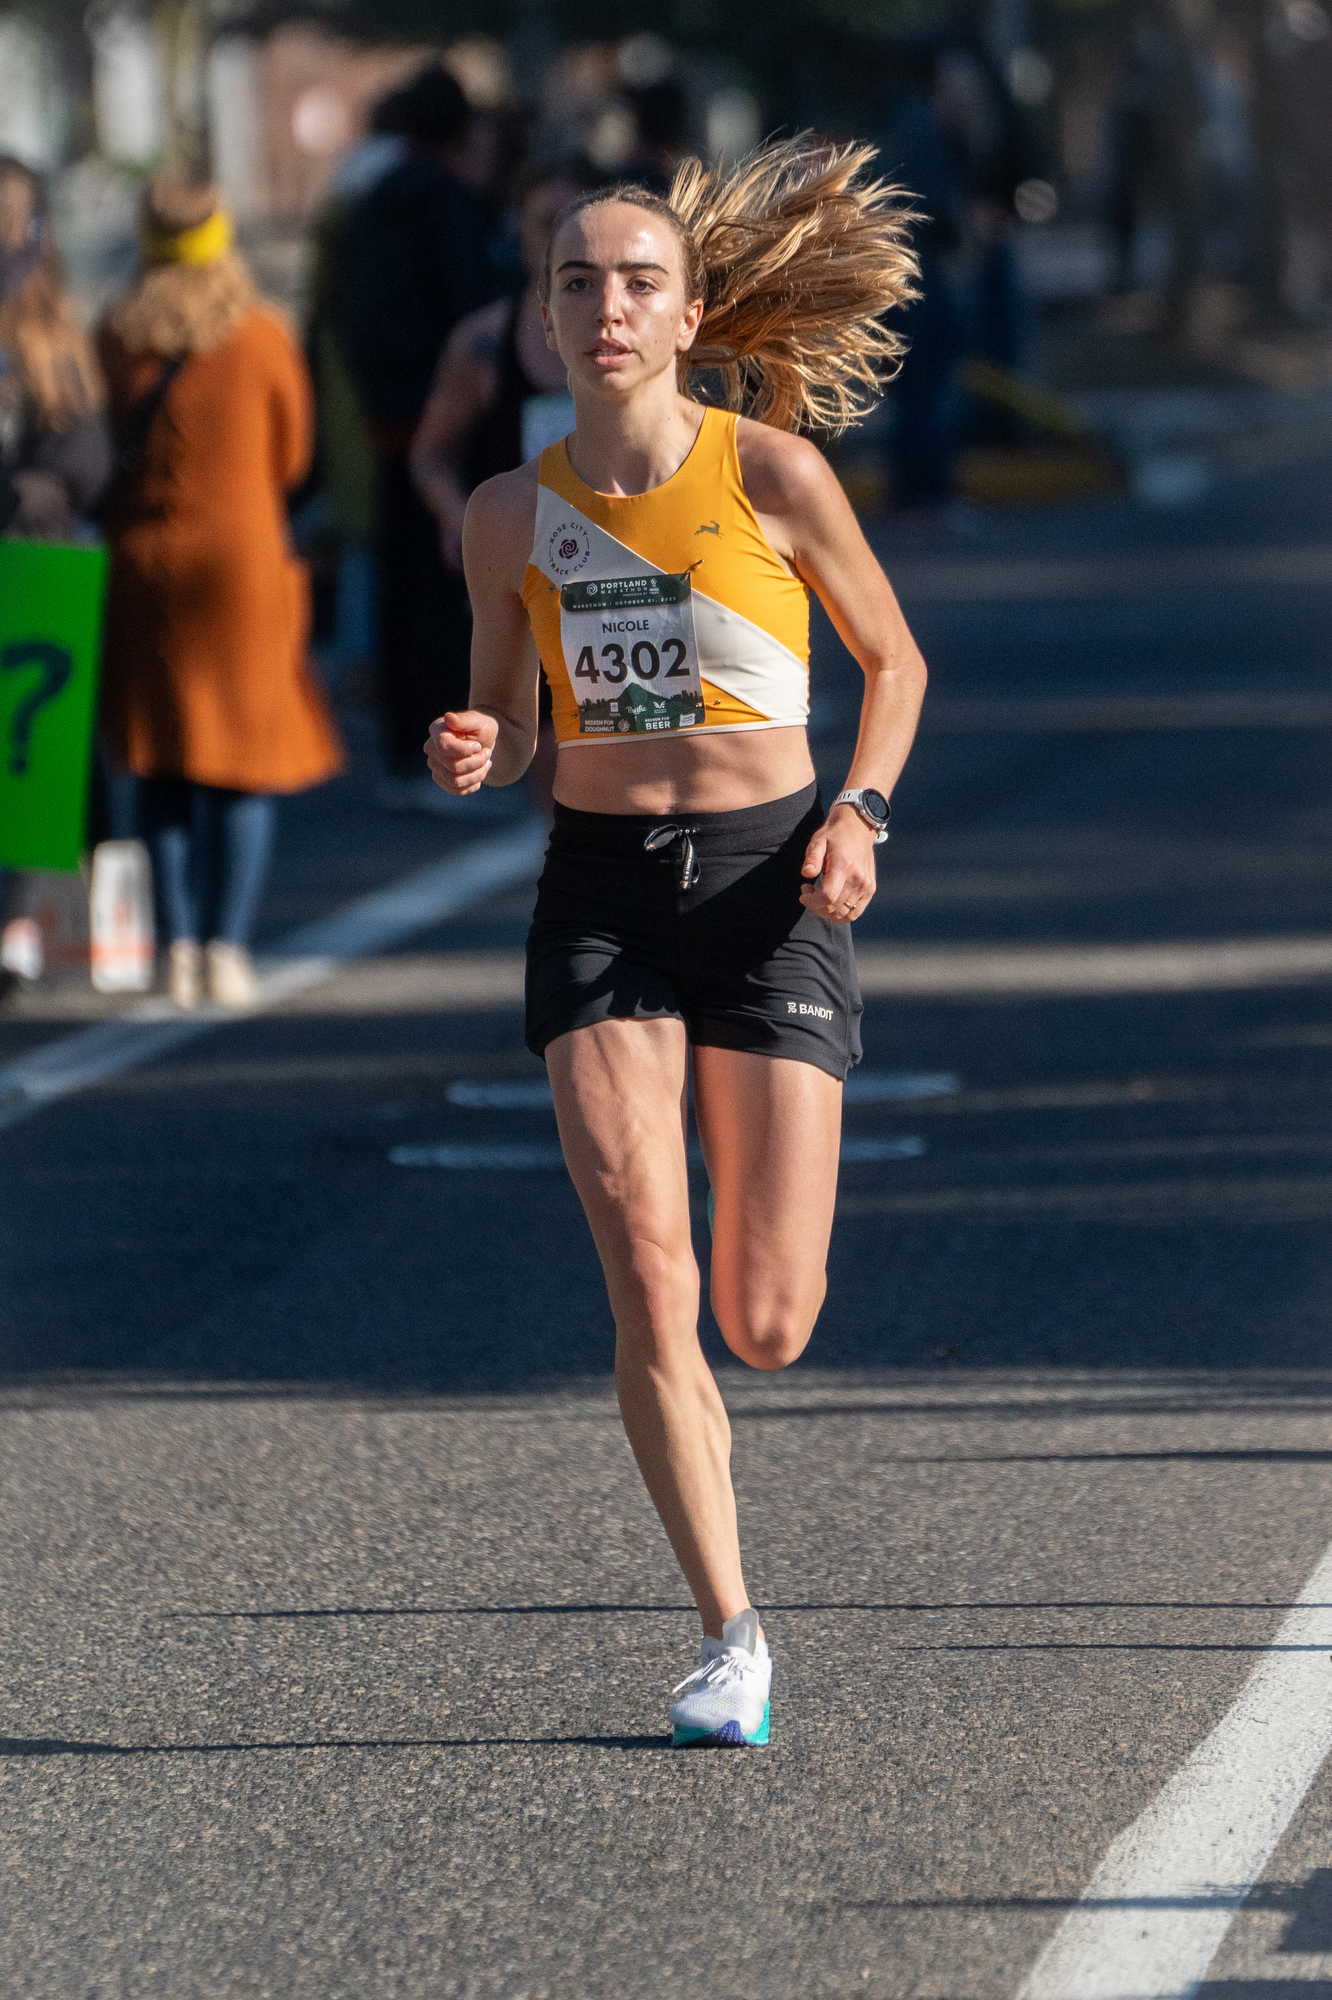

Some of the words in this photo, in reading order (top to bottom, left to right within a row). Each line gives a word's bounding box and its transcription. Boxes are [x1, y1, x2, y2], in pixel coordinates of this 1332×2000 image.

[550, 523, 566, 543] ROSE
[571, 522, 587, 536] CITY
[549, 558, 569, 575] TRACK
[574, 551, 590, 572] CLUB
[600, 580, 647, 590] PORTLAND
[602, 619, 650, 633] NICOLE
[574, 638, 691, 684] 4302
[645, 721, 670, 730] BEER
[799, 1003, 833, 1021] BANDIT
